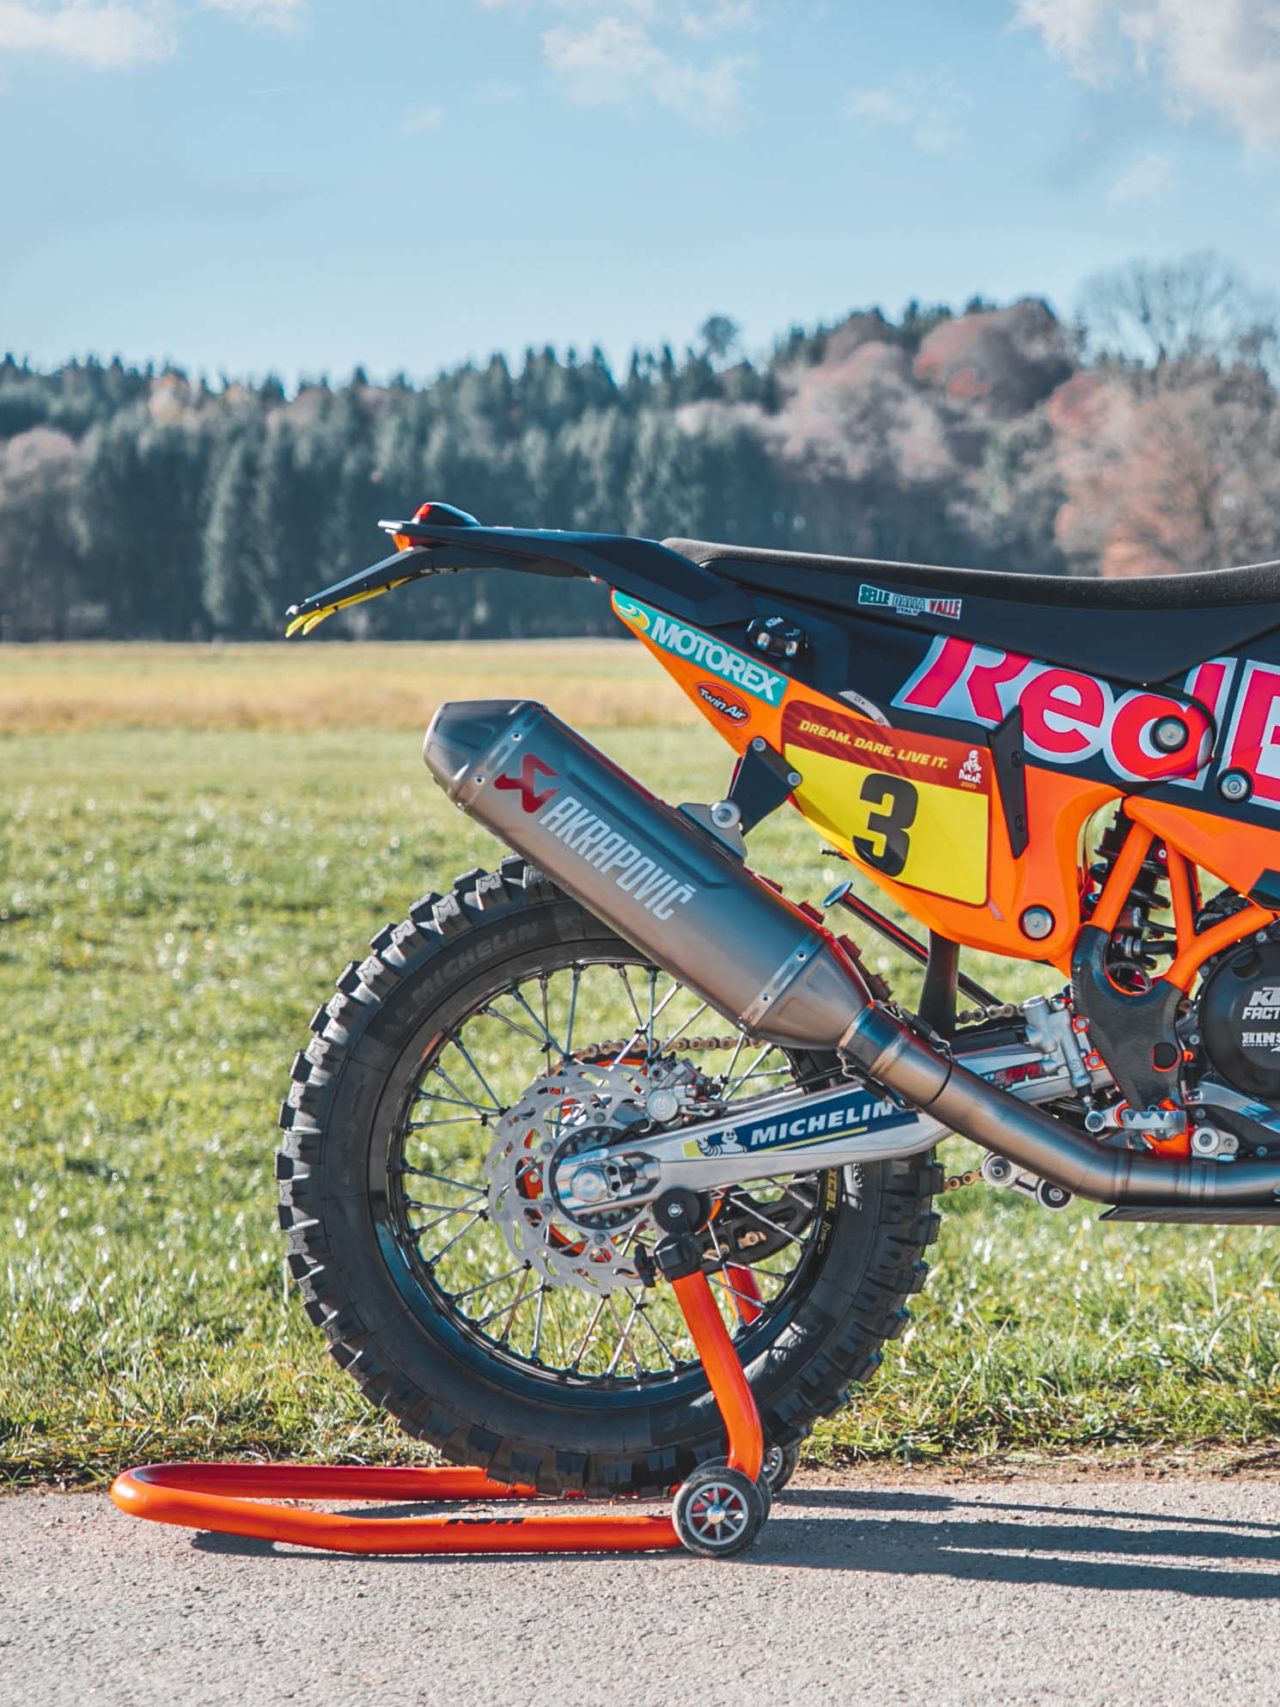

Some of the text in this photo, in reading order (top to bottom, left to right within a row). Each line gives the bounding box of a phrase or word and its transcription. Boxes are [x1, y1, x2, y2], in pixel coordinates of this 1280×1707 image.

[650, 616, 780, 701] MOTOREX
[700, 688, 747, 720] Twin Air
[799, 719, 948, 769] DREAM. DARE. LIVE IT.
[853, 772, 919, 877] 3
[750, 1099, 894, 1146] MICHELIN
[826, 1168, 838, 1212] XCEL
